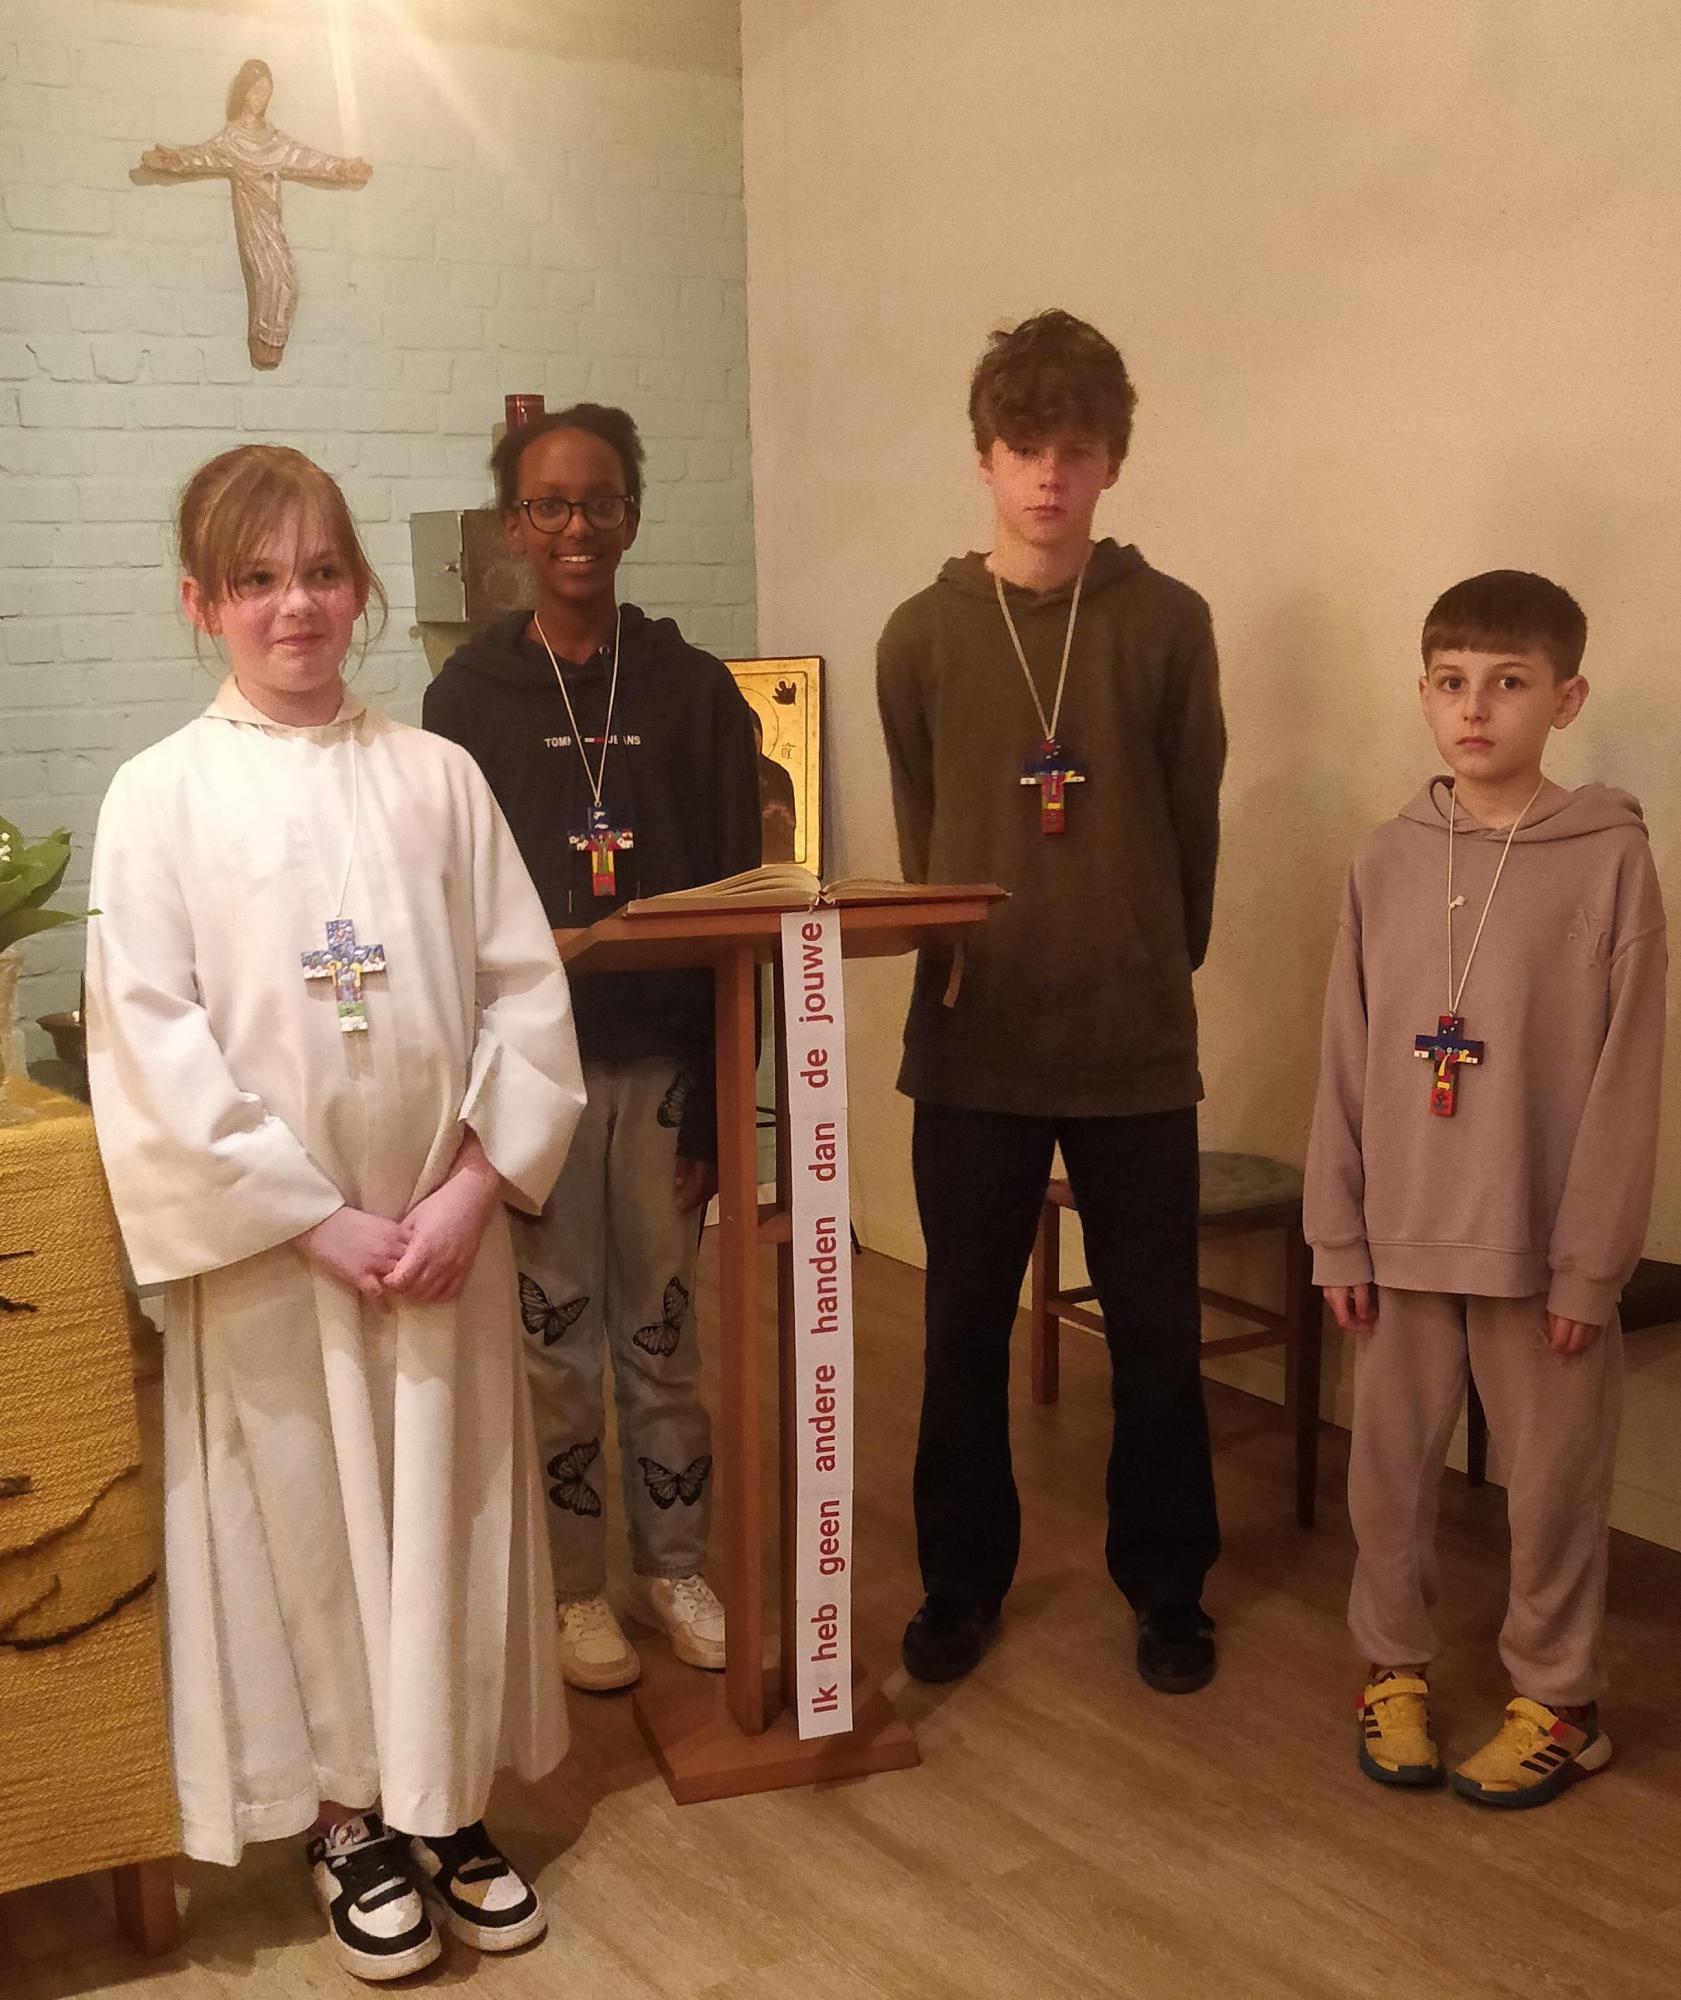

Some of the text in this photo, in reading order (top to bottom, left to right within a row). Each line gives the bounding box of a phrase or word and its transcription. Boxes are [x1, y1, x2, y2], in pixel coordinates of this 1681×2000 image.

[799, 922, 846, 1713] Ik heb geen andere handen dan de jouwe
